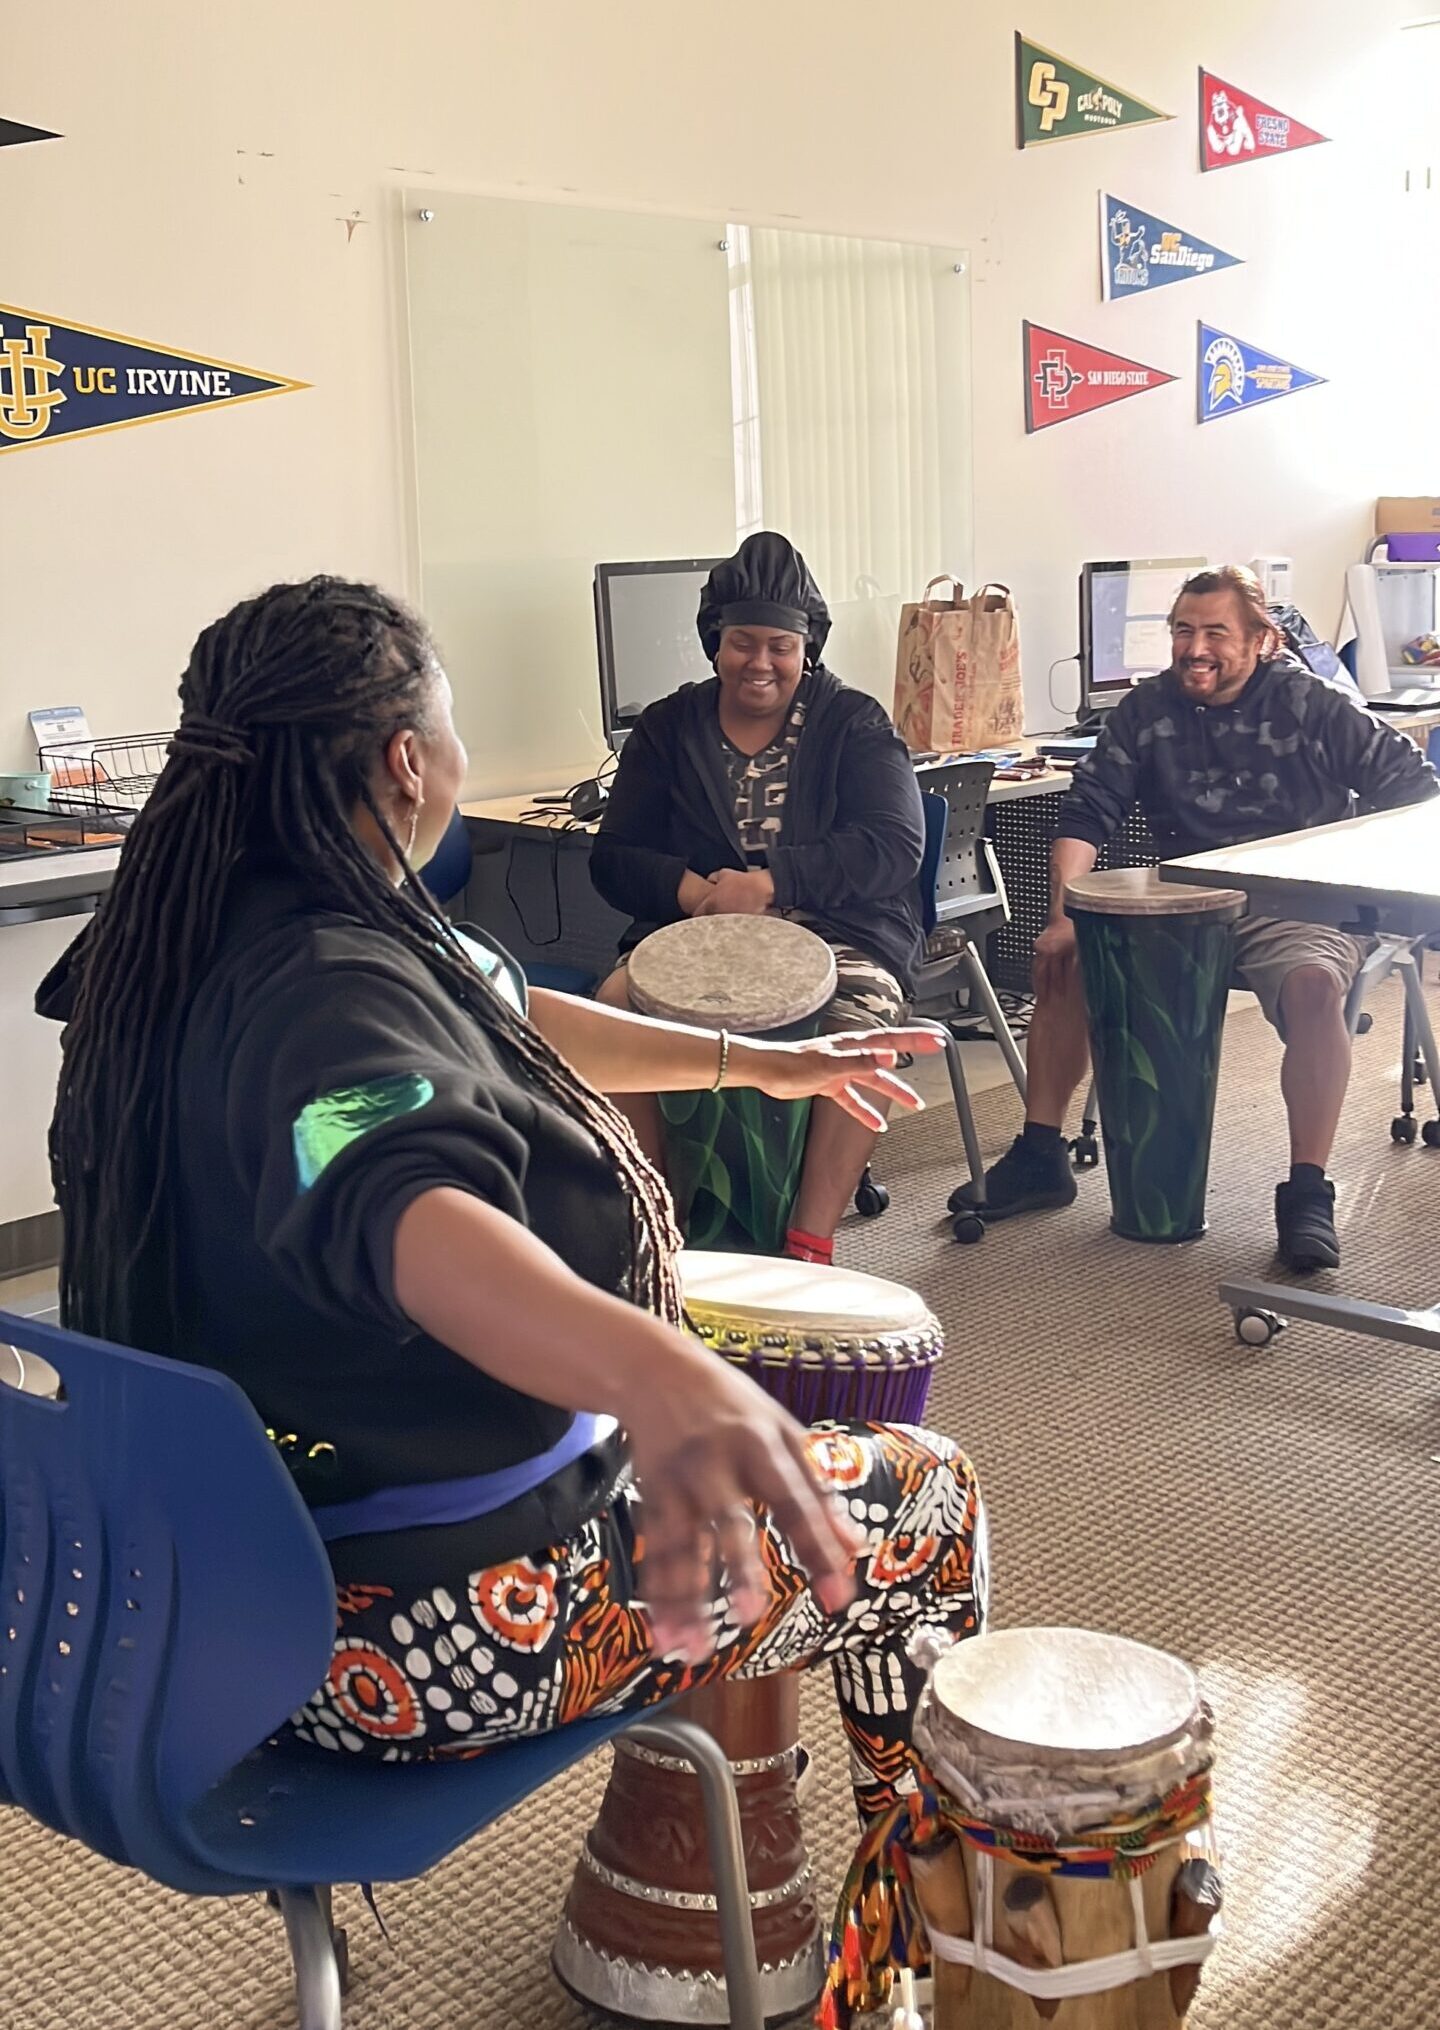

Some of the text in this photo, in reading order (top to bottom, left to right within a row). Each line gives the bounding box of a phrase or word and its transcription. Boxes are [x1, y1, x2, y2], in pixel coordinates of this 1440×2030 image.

[1077, 94, 1123, 118] CAL POLY
[1256, 114, 1290, 132] FRESNO
[1258, 130, 1288, 148] STATE
[72, 366, 231, 396] UC IRVINE
[1087, 371, 1149, 385] SAN DIEGO STATE
[955, 651, 967, 689] JOE'S
